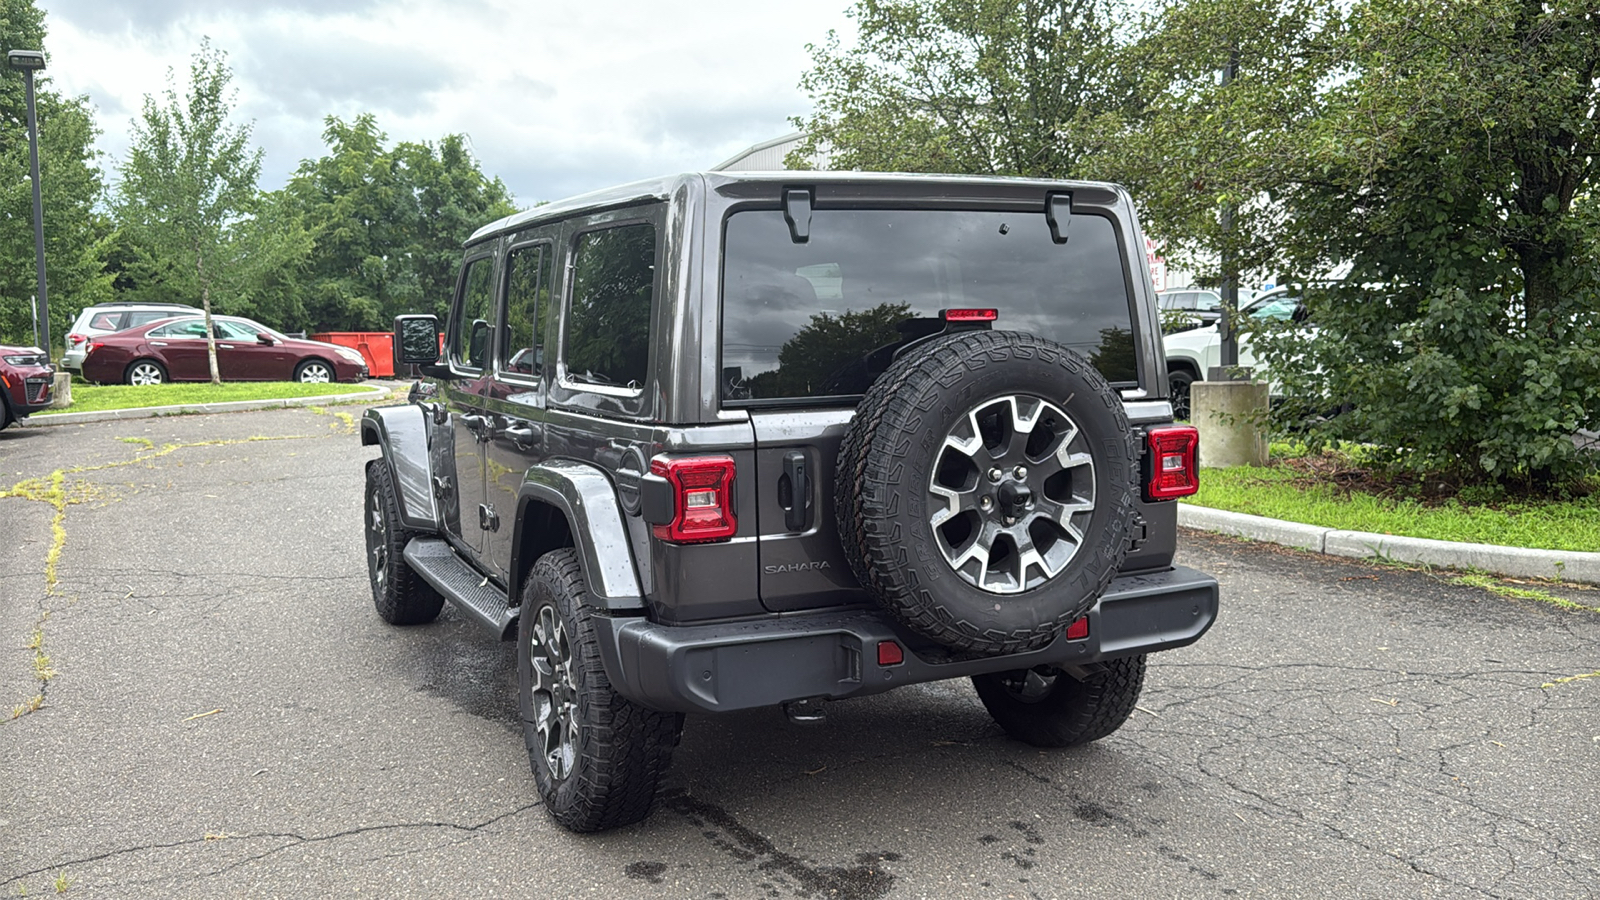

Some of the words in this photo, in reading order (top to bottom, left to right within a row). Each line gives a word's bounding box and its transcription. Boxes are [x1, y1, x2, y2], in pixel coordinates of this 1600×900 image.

[764, 560, 831, 575] SAHARA
[908, 427, 942, 581] GRABBER
[1070, 437, 1126, 590] GENERAL
